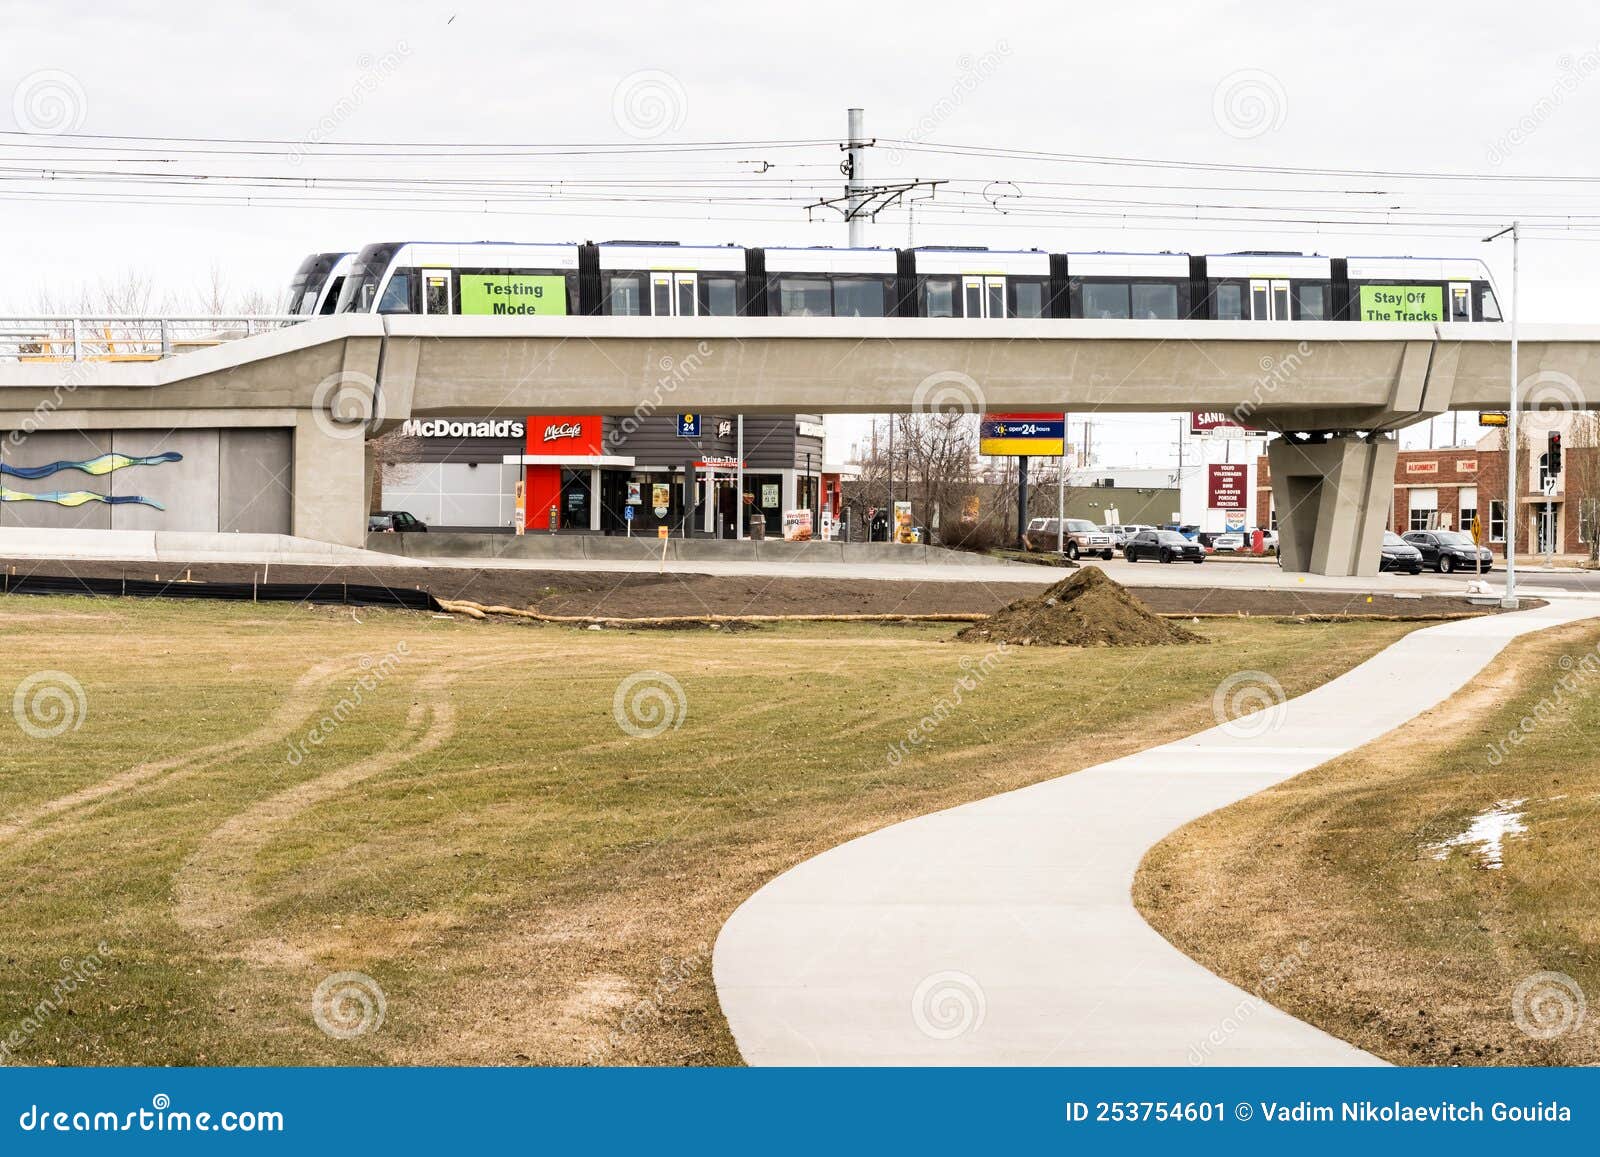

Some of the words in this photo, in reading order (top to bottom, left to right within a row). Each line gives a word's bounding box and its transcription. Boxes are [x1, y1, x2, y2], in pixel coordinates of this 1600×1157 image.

[483, 282, 543, 298] Testing
[1374, 292, 1402, 305] Stay
[1407, 293, 1425, 303] Off
[493, 303, 536, 315] Mode
[1367, 310, 1391, 321] The
[1394, 310, 1438, 321] Tracks
[402, 419, 524, 438] McDonald's
[683, 423, 694, 432] 24
[1022, 424, 1036, 435] 24
[702, 455, 740, 463] Drive-Thr
